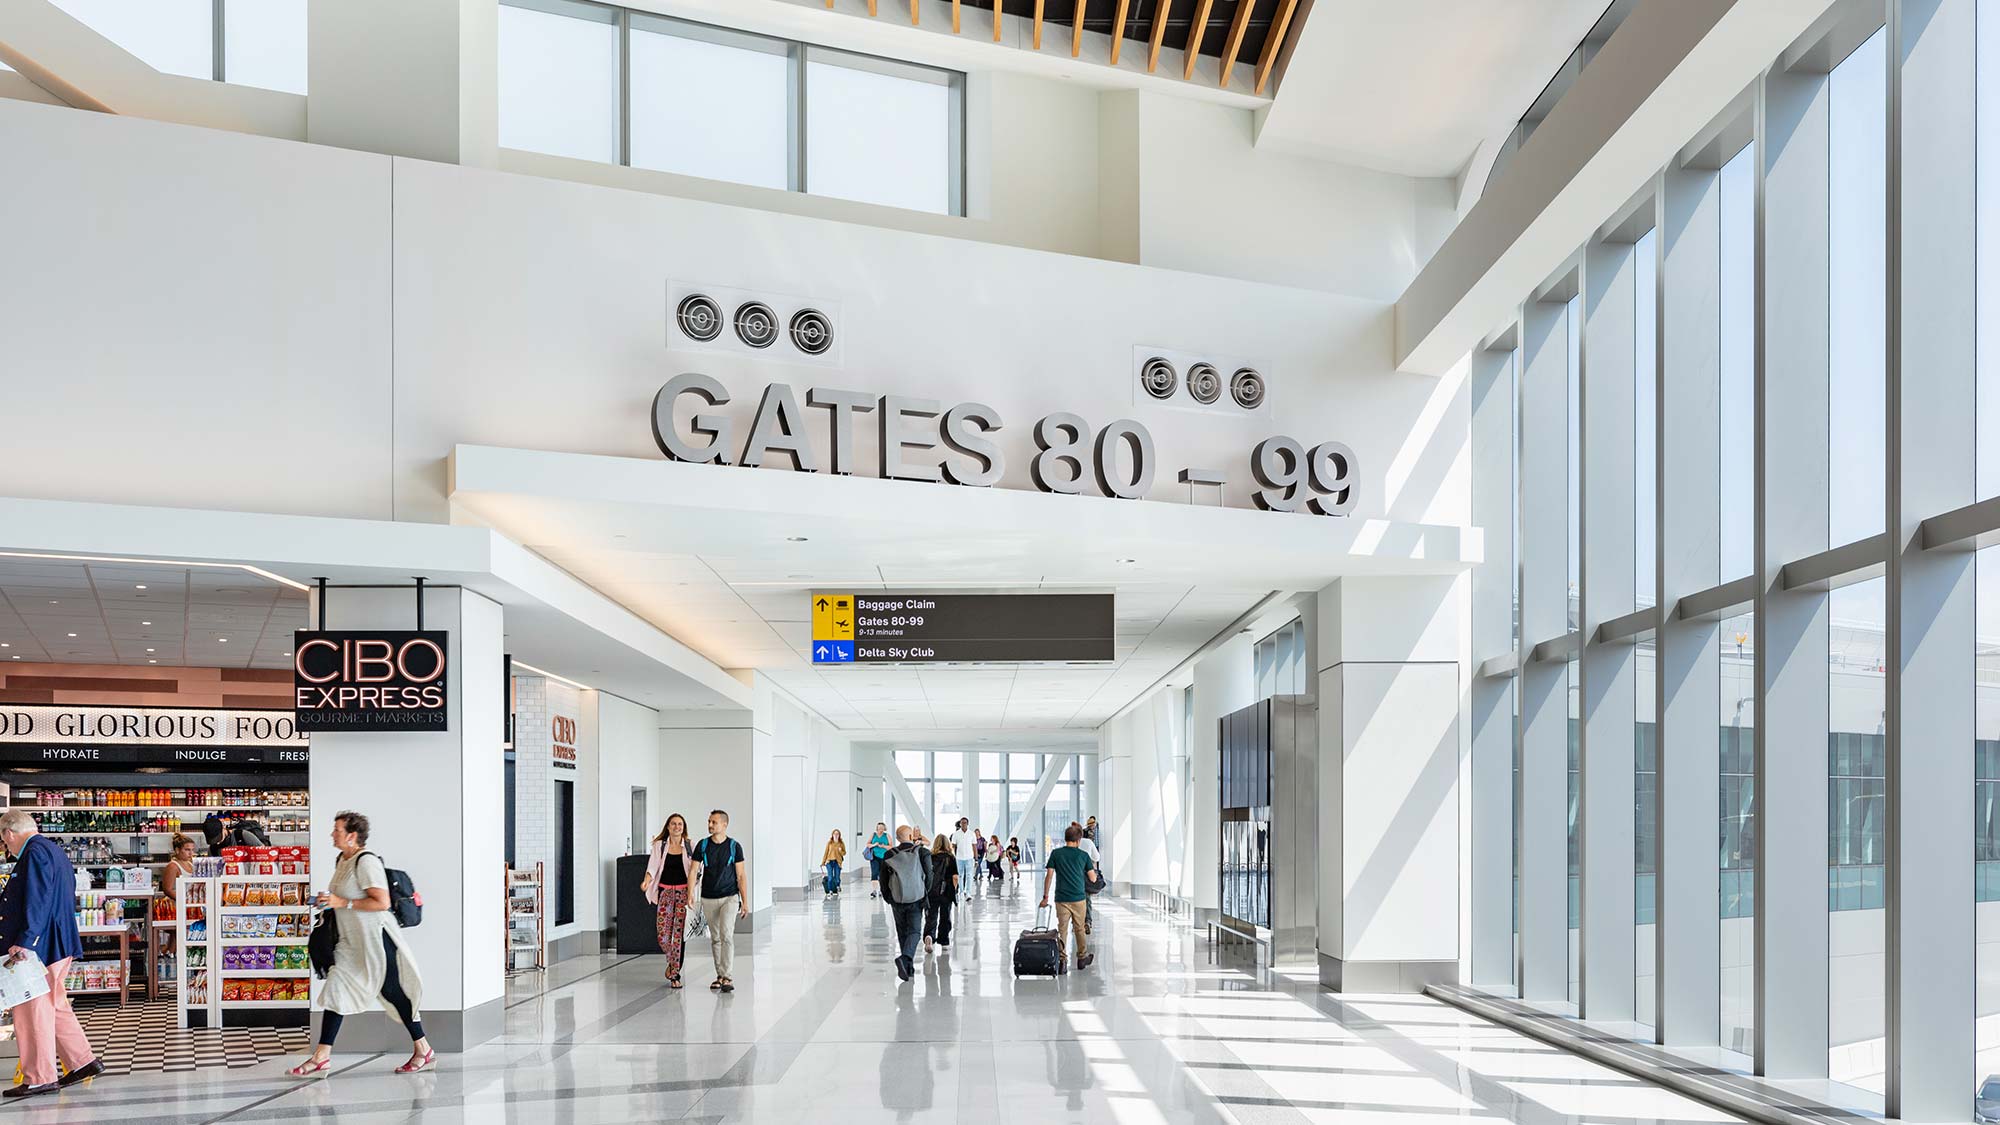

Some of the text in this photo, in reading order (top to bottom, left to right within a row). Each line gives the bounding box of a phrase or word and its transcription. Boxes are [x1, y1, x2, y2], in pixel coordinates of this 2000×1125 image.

[651, 373, 1004, 488] GATES
[1030, 412, 1155, 498] 80
[1250, 435, 1361, 516] 99
[858, 599, 935, 611] Baggage Claim
[858, 616, 924, 626] Gates 80-99
[858, 647, 935, 659] Delta Sky Club
[295, 638, 445, 683] CIBO
[297, 686, 444, 709] EXPRESS
[300, 711, 444, 723] GOURMET MARKETS
[55, 713, 216, 739] GLORIOUS
[552, 714, 576, 745] CIBO
[43, 749, 99, 759] HYDRATE
[175, 750, 227, 760] INDULGE
